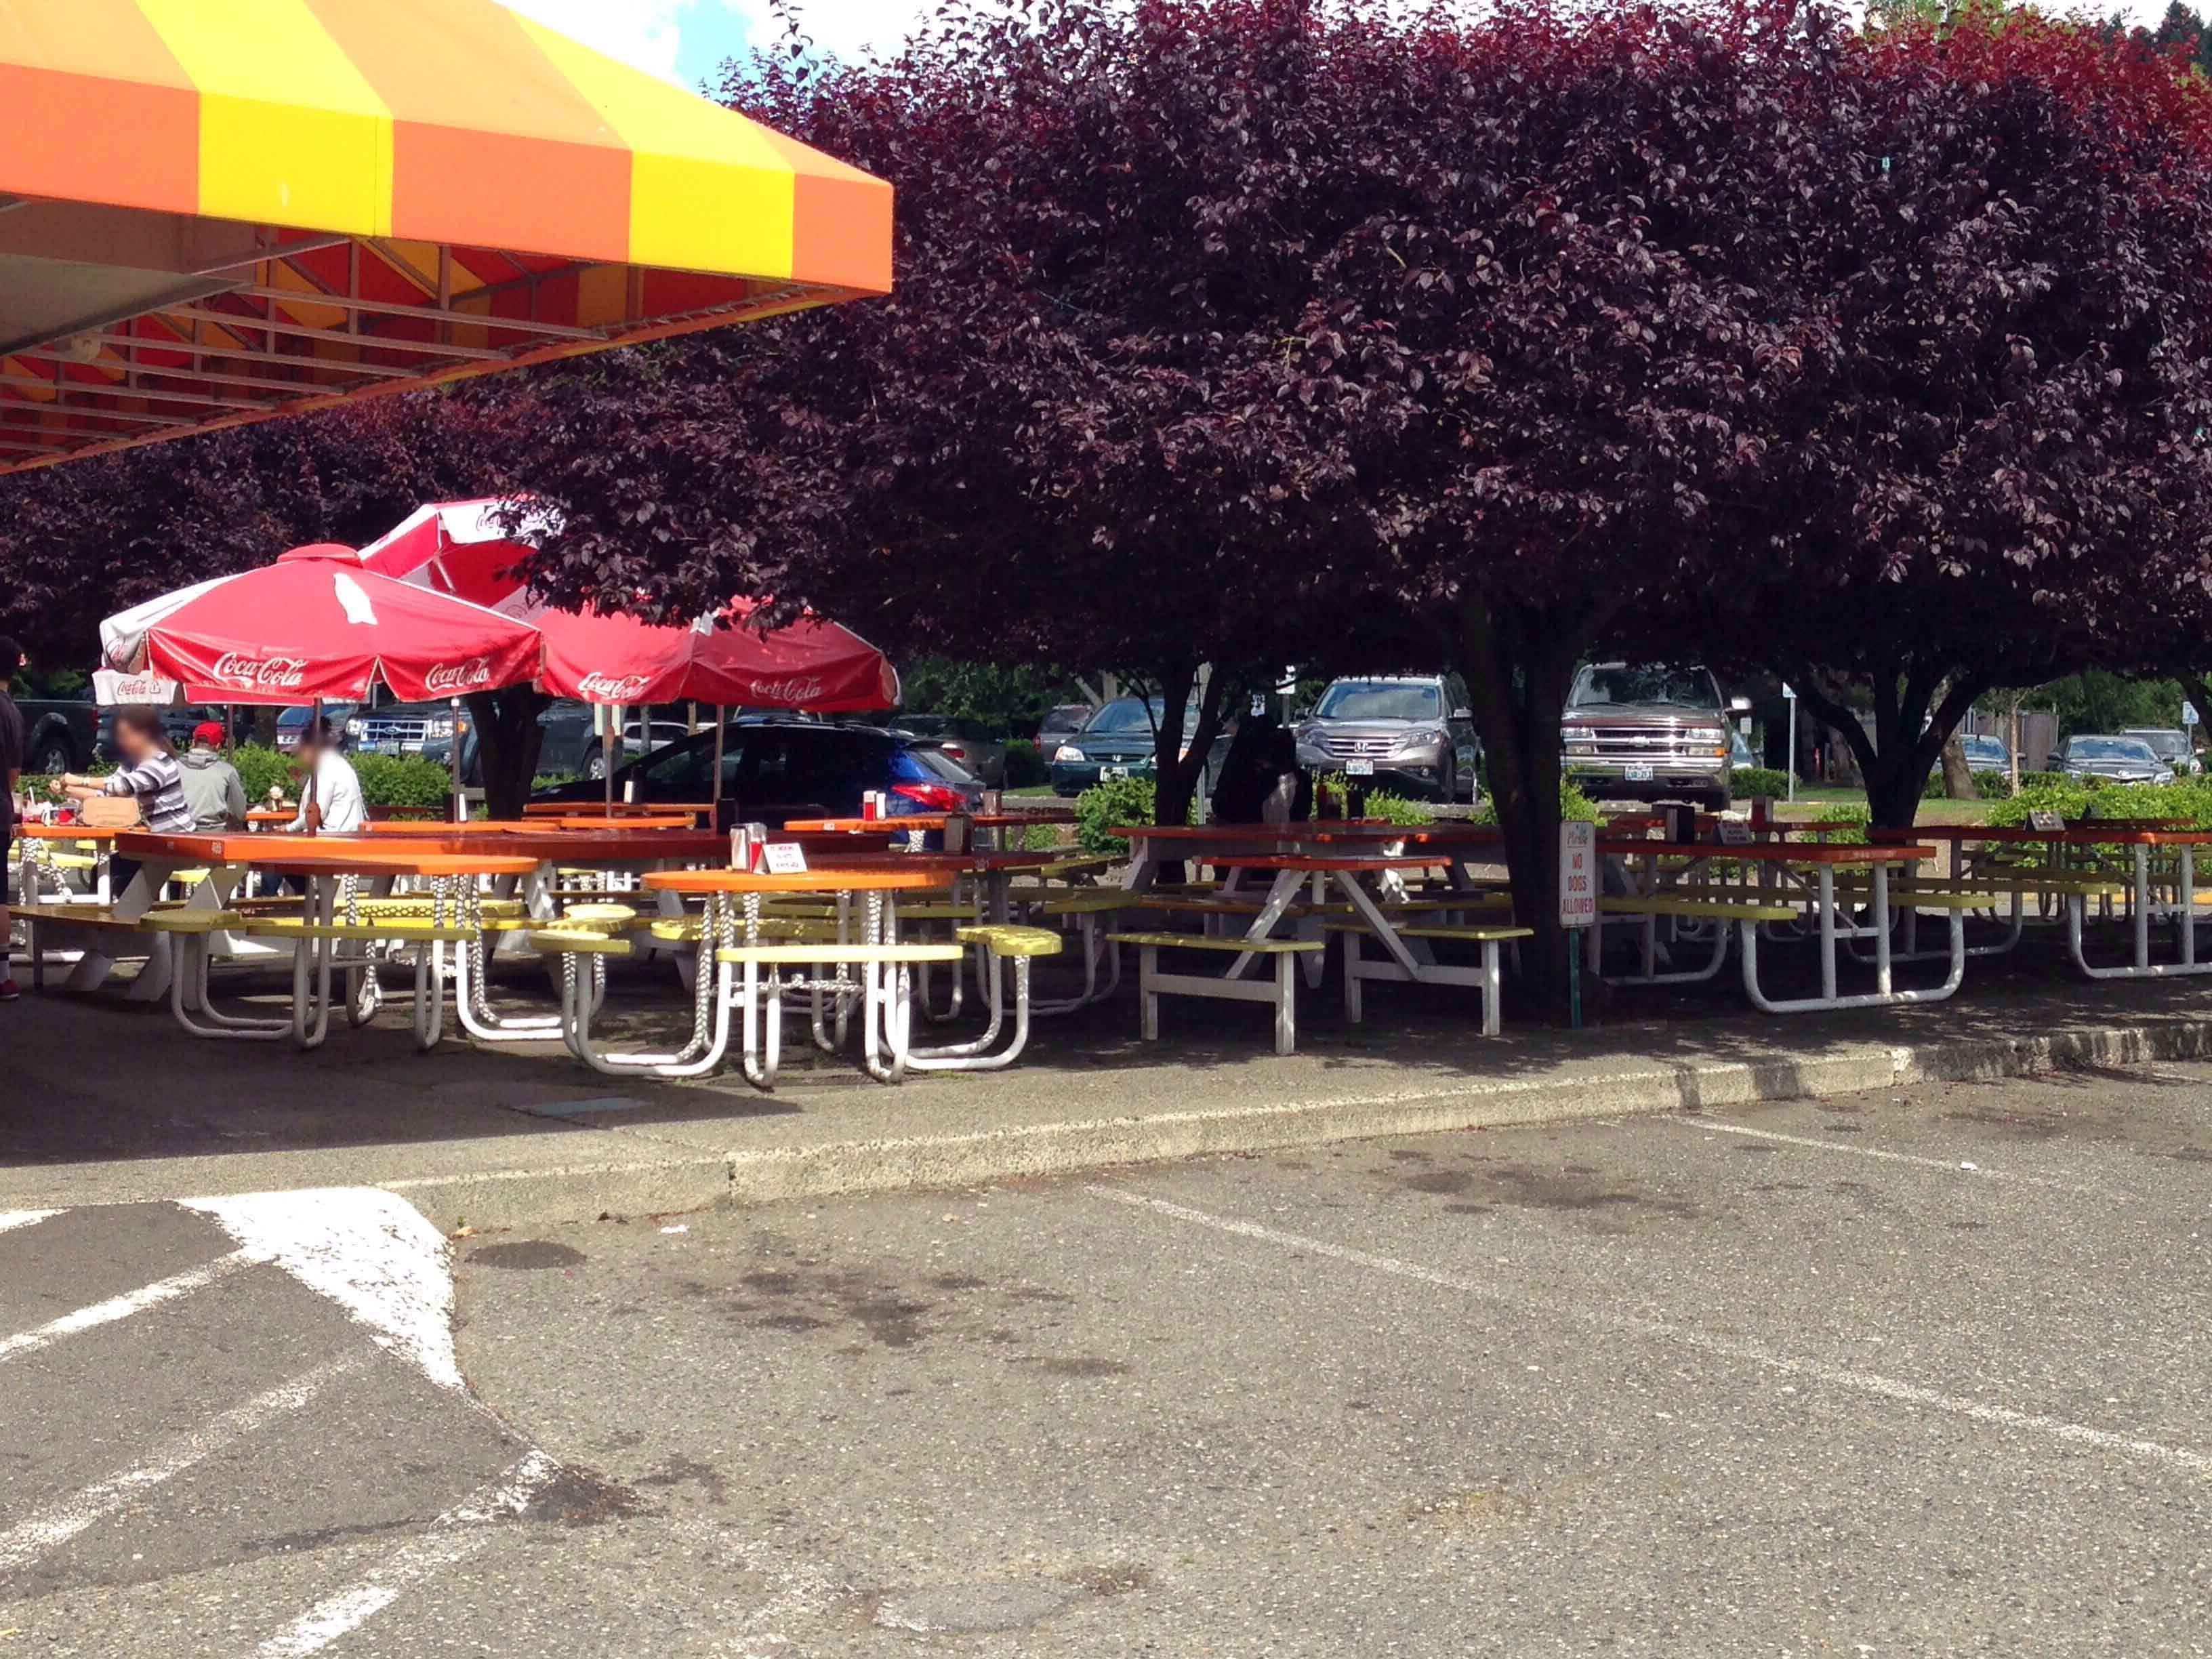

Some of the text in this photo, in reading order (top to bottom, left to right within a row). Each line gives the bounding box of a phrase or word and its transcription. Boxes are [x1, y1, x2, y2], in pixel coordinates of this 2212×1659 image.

[213, 651, 308, 688] Coca-Cola
[1572, 853, 1582, 869] NO
[1568, 875, 1587, 892] DOGS
[1561, 897, 1593, 914] ALLOWED
